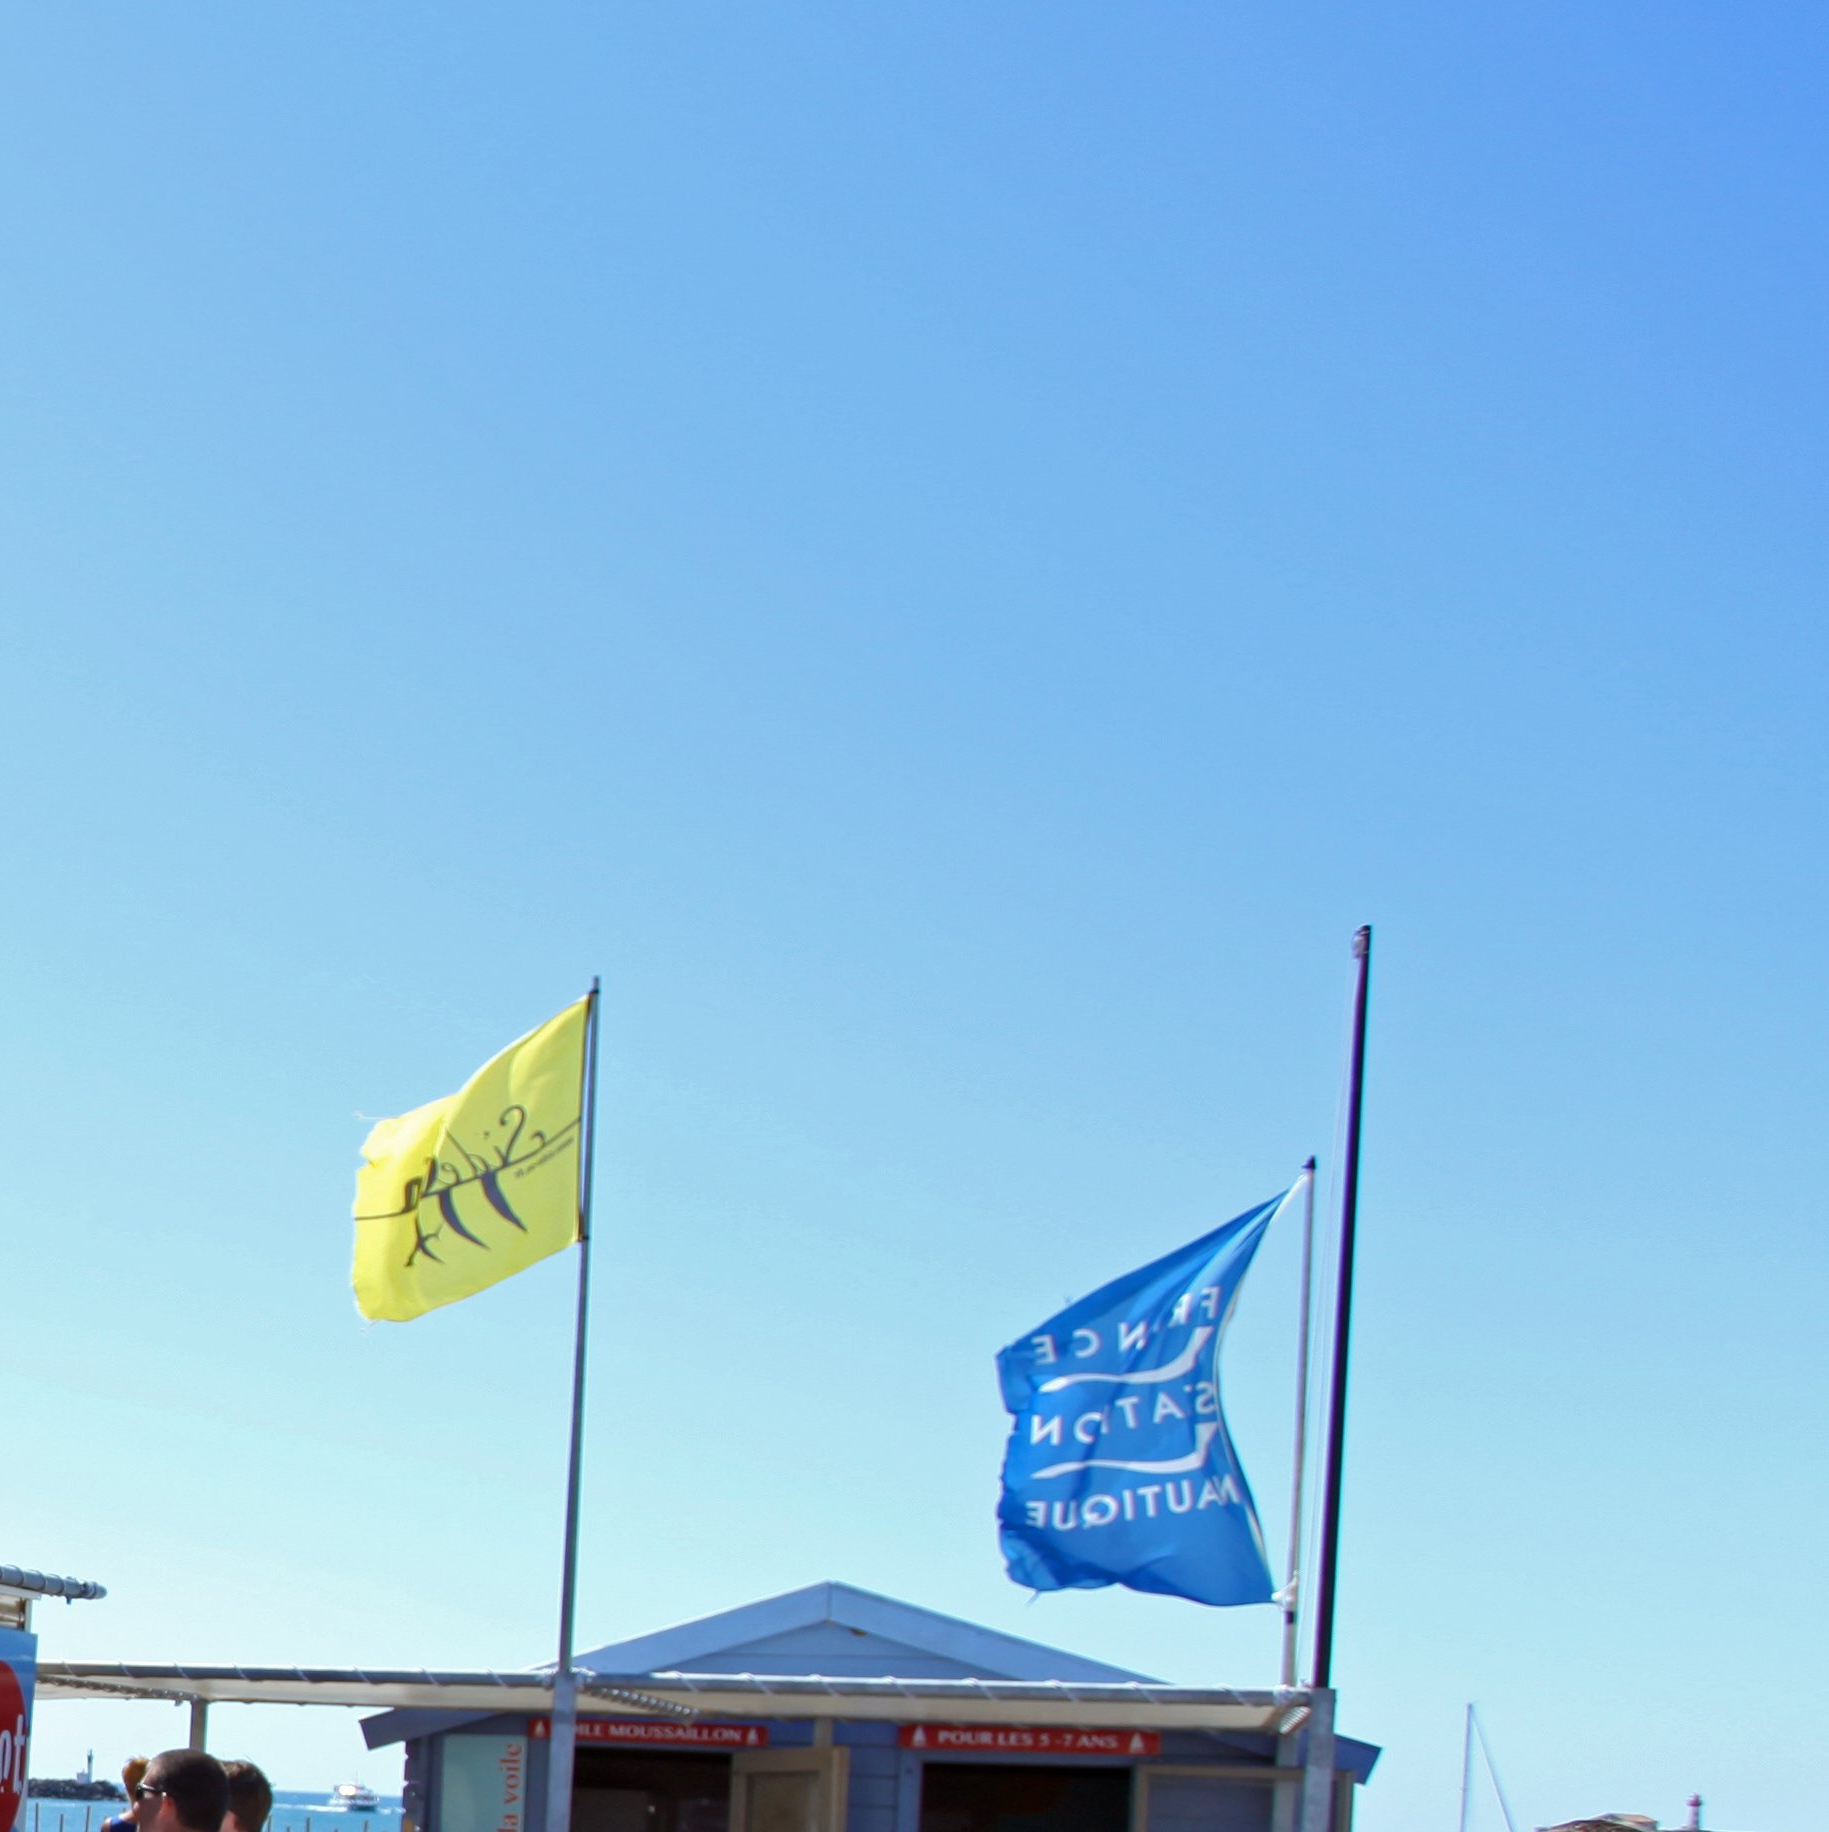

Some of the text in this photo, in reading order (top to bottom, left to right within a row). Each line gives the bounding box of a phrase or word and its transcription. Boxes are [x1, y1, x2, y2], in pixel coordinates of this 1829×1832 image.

[576, 1721, 743, 1743] ILE MOUSSAILLON
[938, 1729, 992, 1745] POUR
[997, 1731, 1032, 1747] LES
[1077, 1734, 1119, 1750] ANS
[498, 1742, 521, 1805] voile
